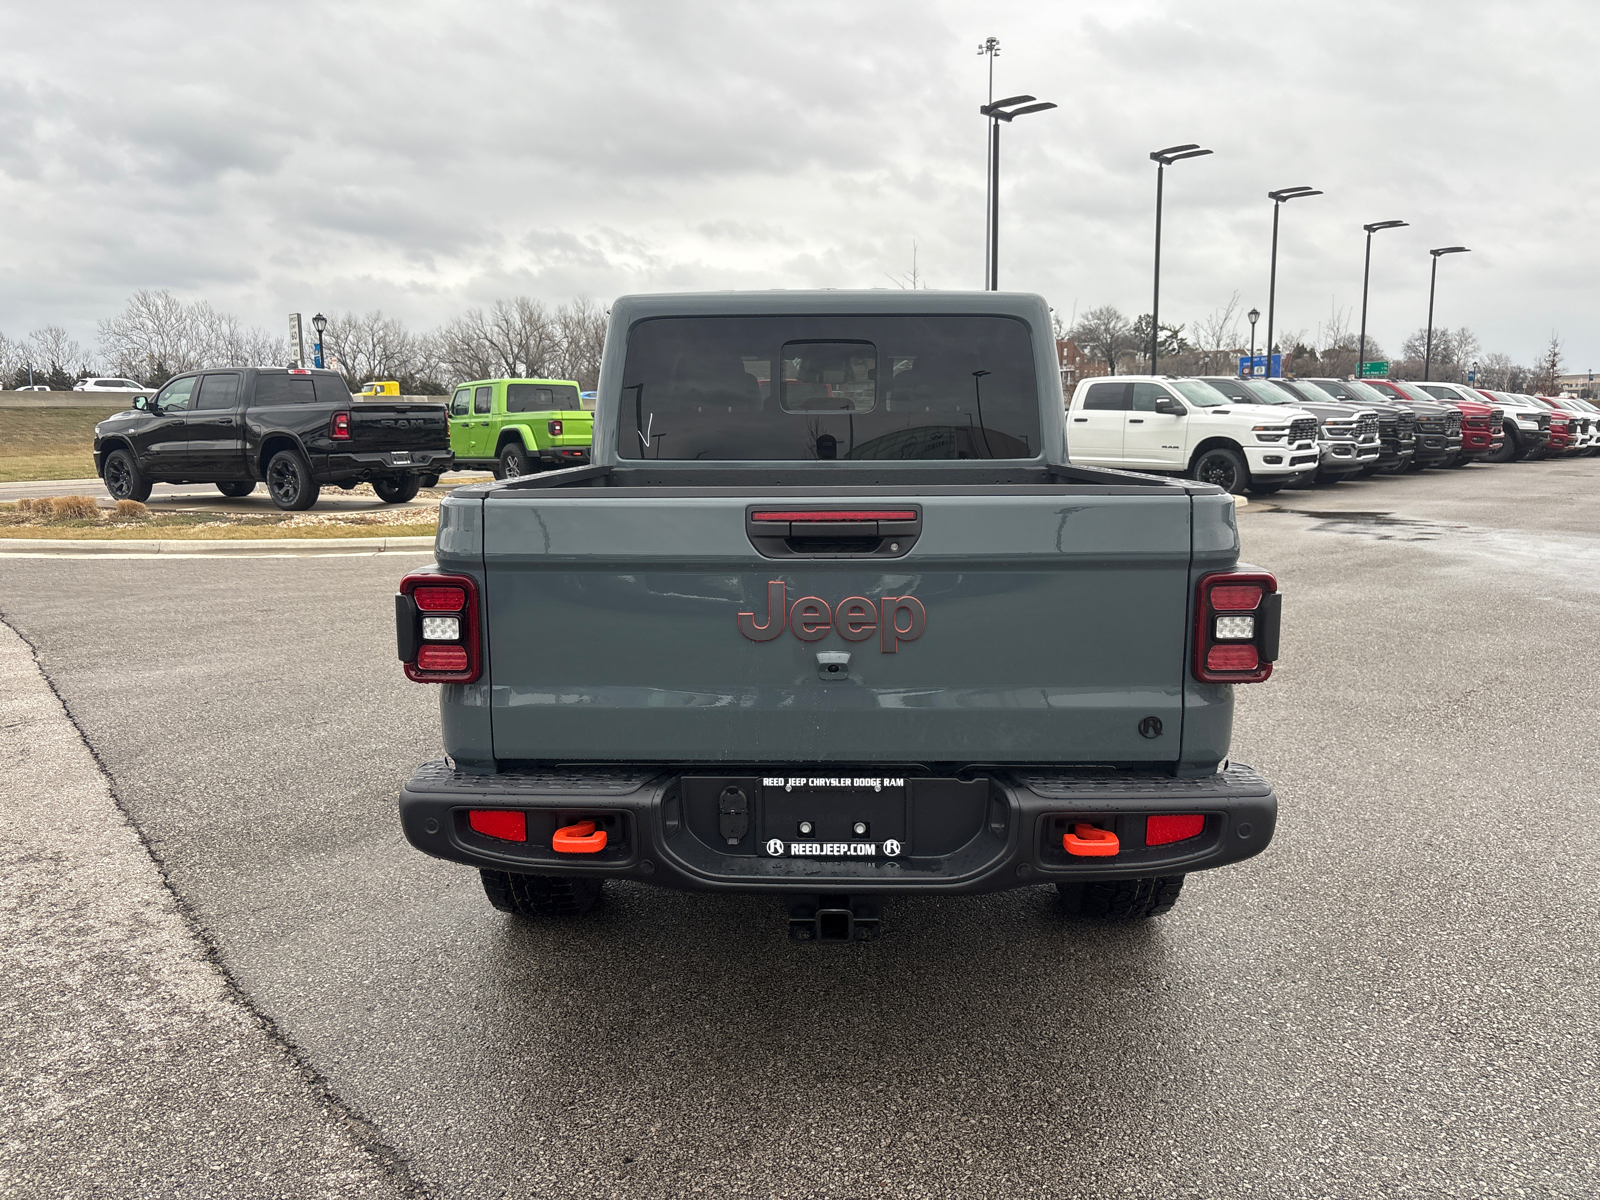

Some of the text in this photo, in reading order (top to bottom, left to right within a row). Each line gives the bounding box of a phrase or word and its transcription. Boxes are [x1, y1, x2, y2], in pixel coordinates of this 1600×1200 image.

[380, 419, 425, 429] RAM
[737, 580, 926, 654] Jeep
[763, 777, 904, 788] REED JEEP CHRYSLER DODGE RAM
[790, 843, 876, 856] REEDJEEP.COM
